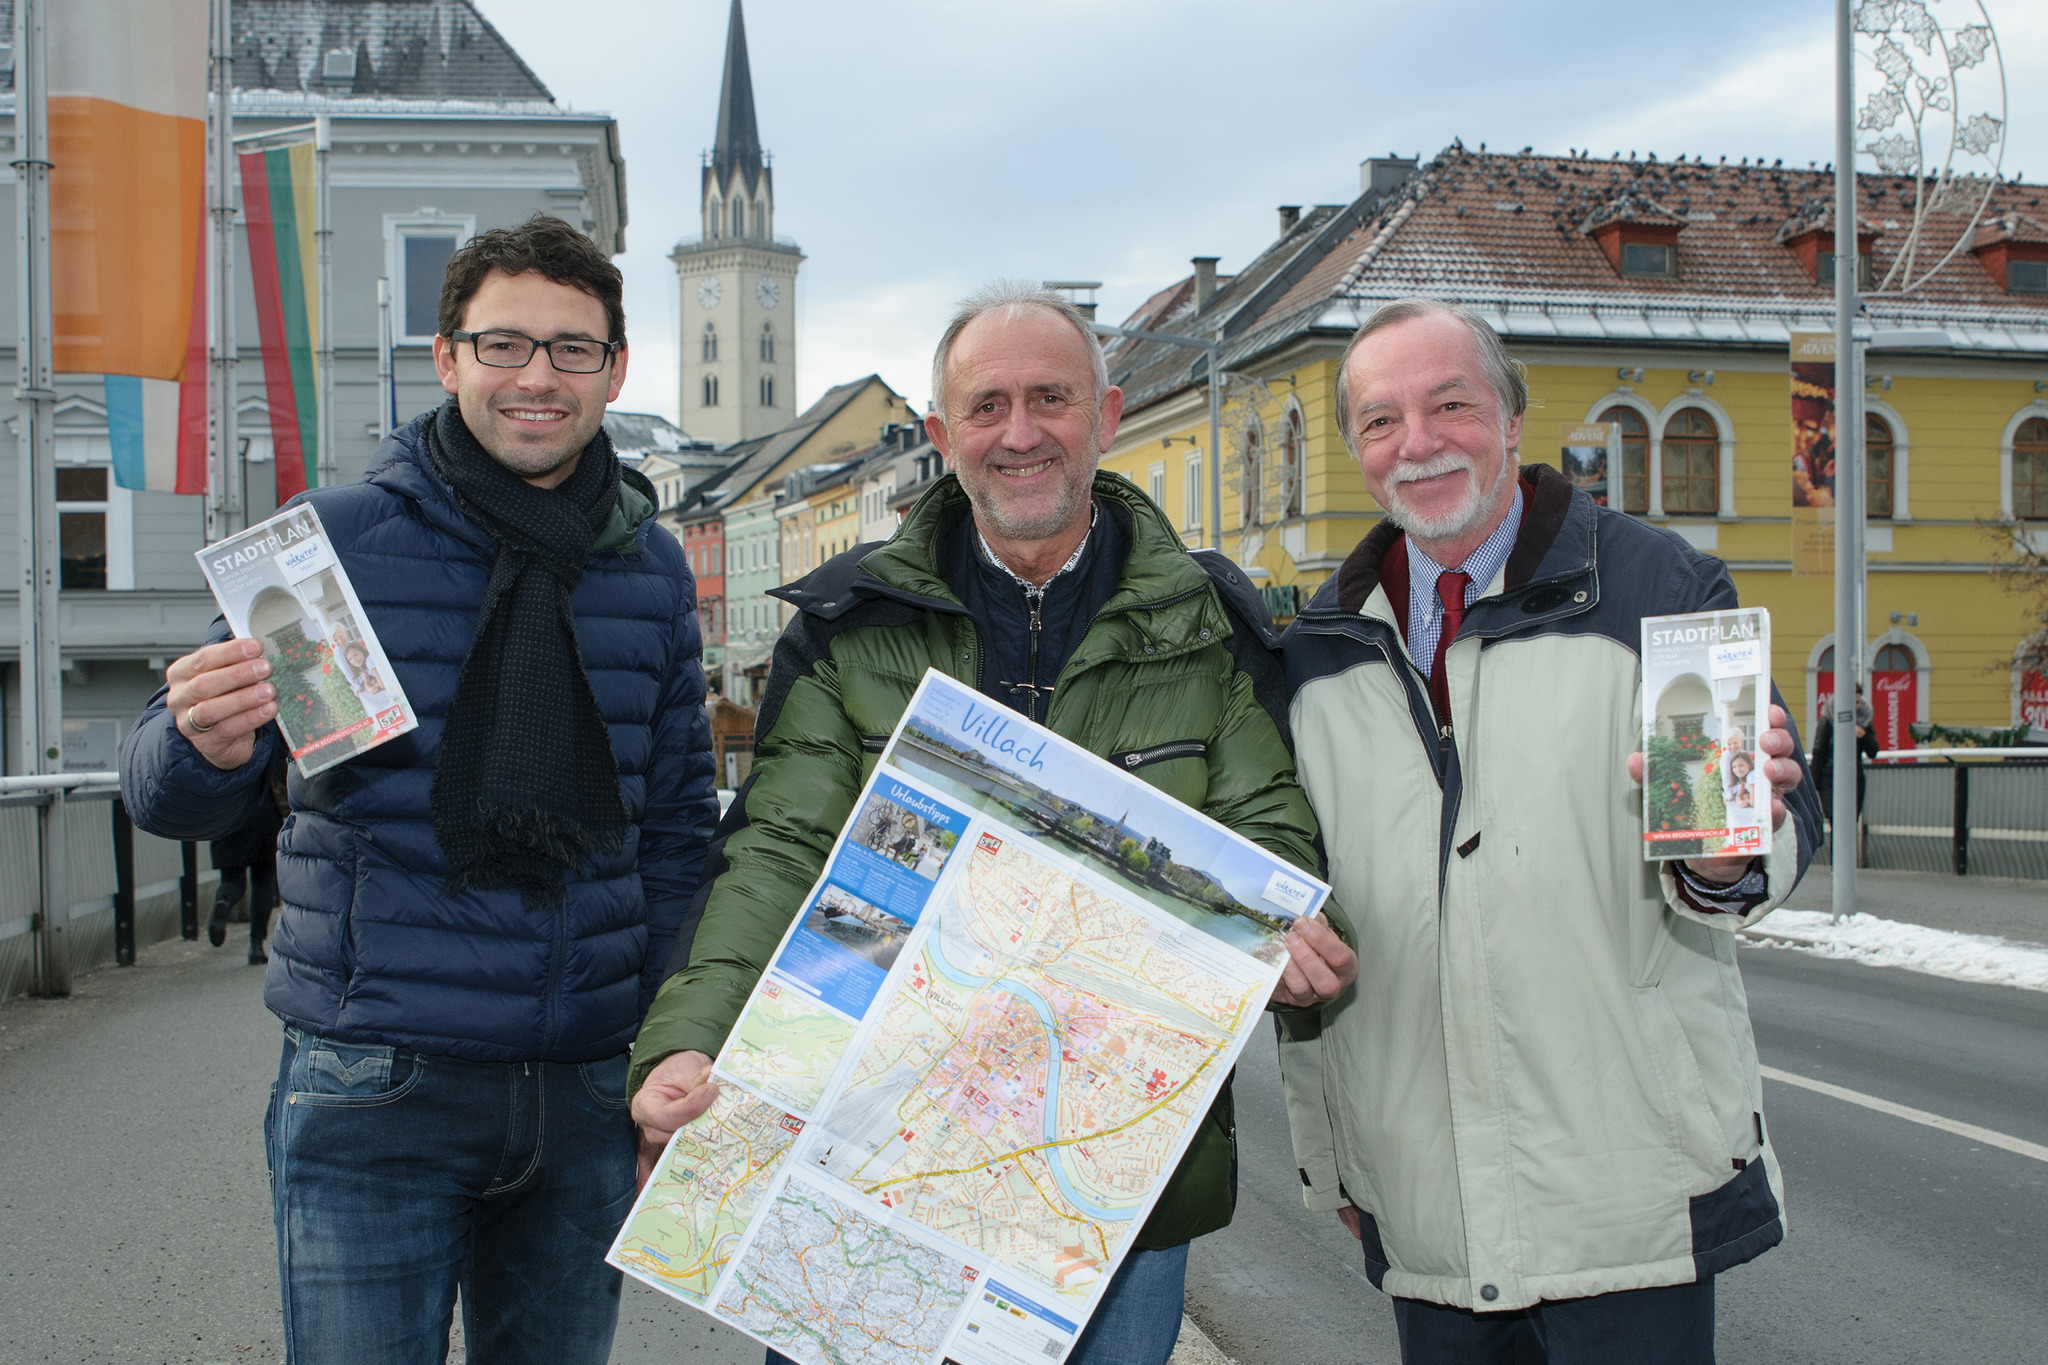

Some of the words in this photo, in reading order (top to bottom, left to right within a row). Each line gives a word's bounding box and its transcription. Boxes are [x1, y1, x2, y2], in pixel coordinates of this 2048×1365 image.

[1797, 343, 1835, 355] ADVEN
[211, 519, 311, 576] STADTPLAN
[1651, 623, 1754, 645] STADTPLAN
[961, 702, 1048, 772] Villach
[1887, 691, 1899, 764] SLAMANDER
[890, 784, 951, 824] Urlaubstipps
[929, 990, 963, 1014] VILLACH
